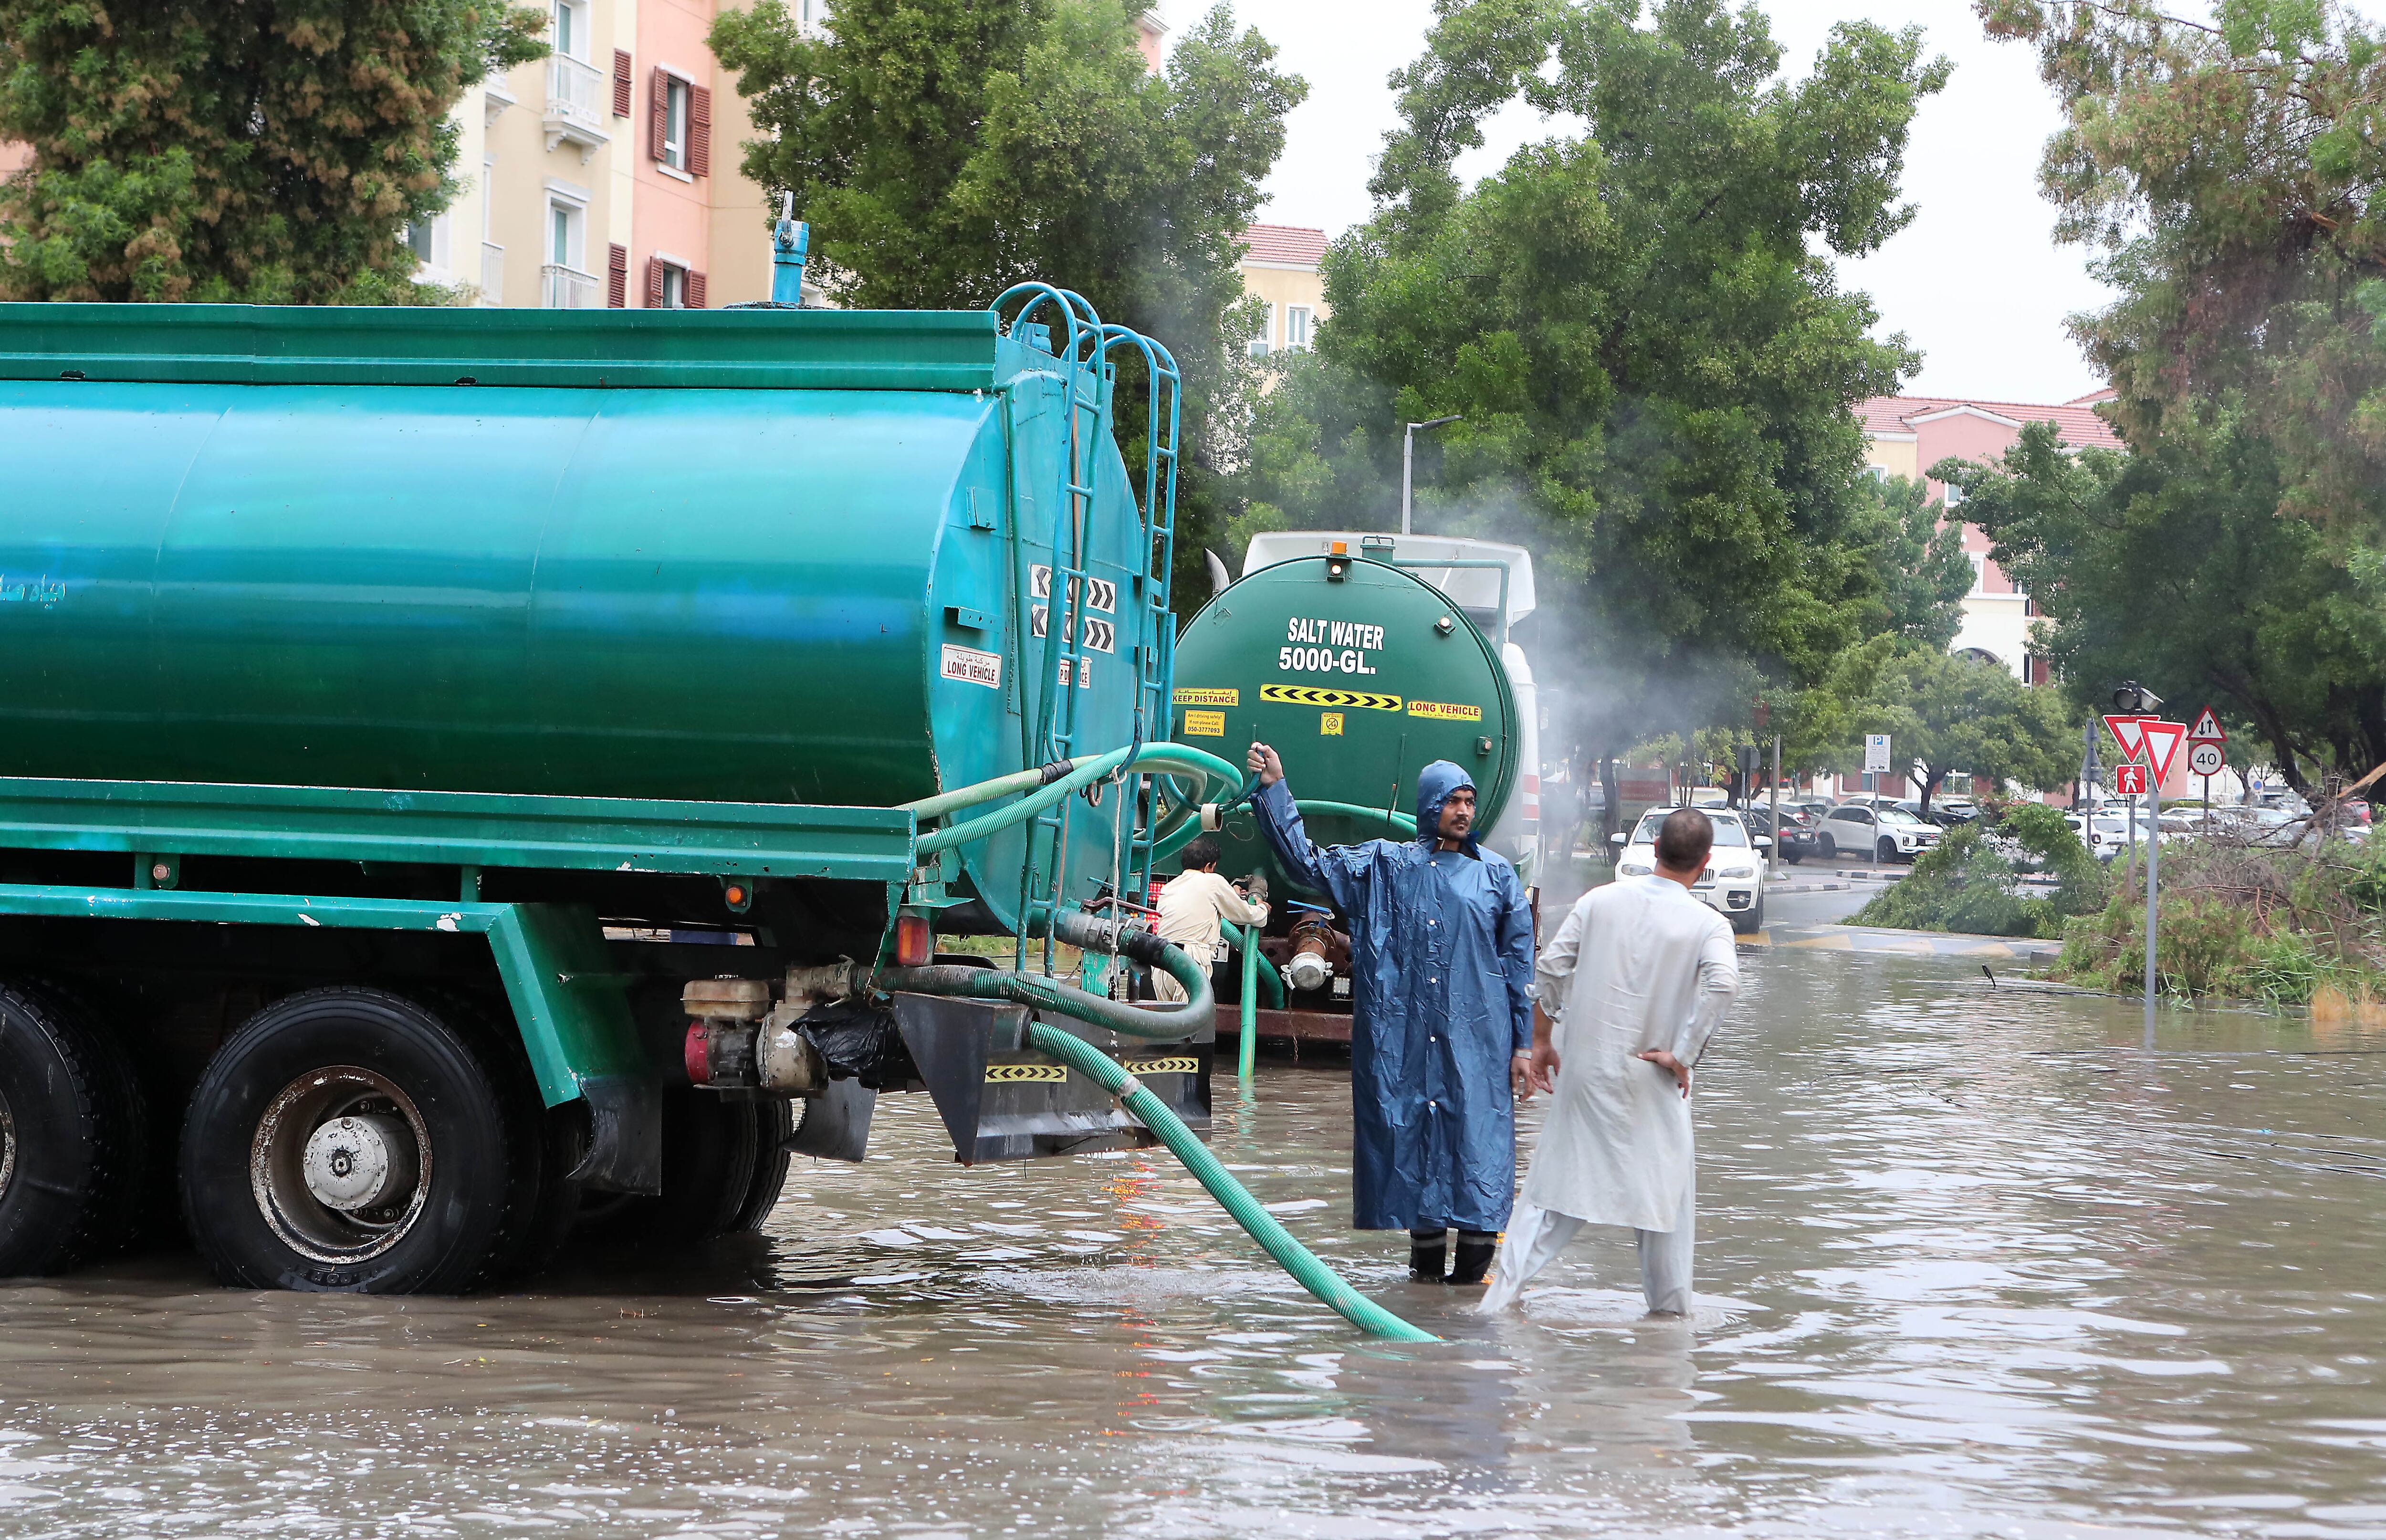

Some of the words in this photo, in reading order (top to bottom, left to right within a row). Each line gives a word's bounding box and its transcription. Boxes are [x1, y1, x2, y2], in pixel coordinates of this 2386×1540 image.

[1287, 617, 1328, 644] SALT
[1330, 620, 1384, 651] WATER
[956, 652, 973, 663] طويلة
[974, 656, 990, 667] مركبة
[1278, 646, 1377, 675] 5000-GL.
[947, 660, 966, 676] LONG
[970, 665, 995, 681] VEHICLE
[1195, 695, 1235, 703] DISTANCE
[1410, 702, 1436, 712] LONG
[1440, 705, 1479, 716] VEHICLE
[2197, 753, 2217, 765] 40
